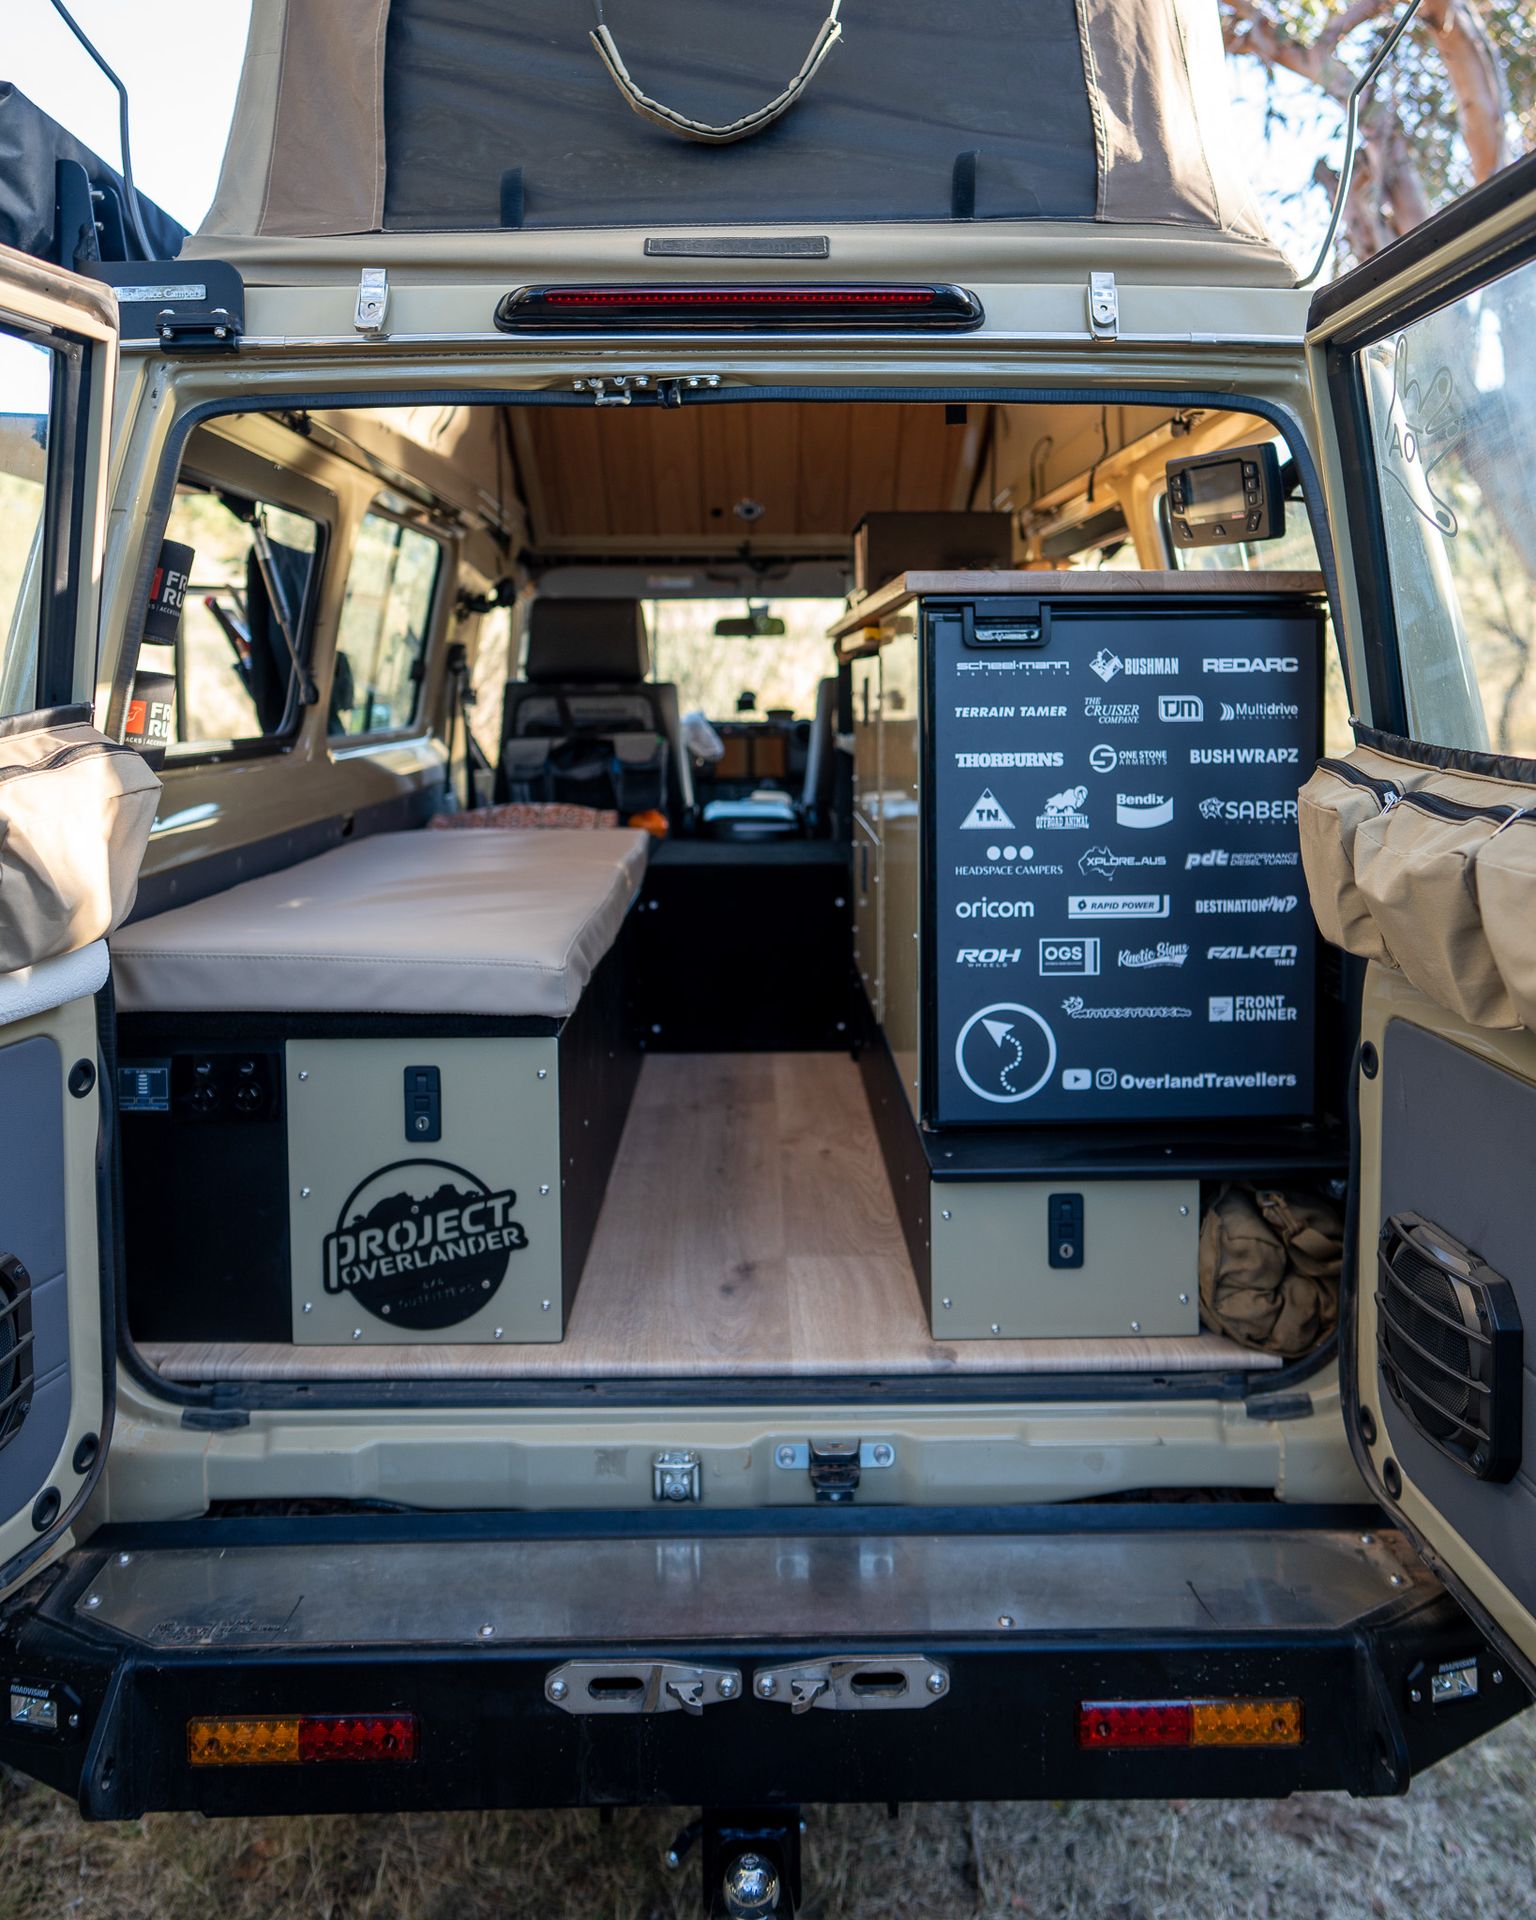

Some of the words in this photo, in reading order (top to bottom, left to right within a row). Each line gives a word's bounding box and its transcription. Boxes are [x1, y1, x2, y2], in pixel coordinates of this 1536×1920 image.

[1125, 658, 1179, 675] BUSHMAN
[1203, 657, 1299, 673] REDARC
[1084, 697, 1102, 705] THE
[1162, 699, 1200, 718] TJM
[1236, 702, 1299, 715] Multidrive
[955, 706, 1015, 718] TERRAIN
[1020, 705, 1067, 717] TAMER
[1084, 704, 1140, 717] CRUISER
[125, 736, 142, 744] ACKS
[955, 752, 1064, 768] THORBURNS
[1119, 751, 1137, 759] ONE
[1139, 750, 1168, 759] STONE
[1119, 758, 1168, 766] ARMRESTS
[1117, 794, 1164, 806] Bendix
[1225, 801, 1298, 819] SABER
[1185, 849, 1229, 871] pdt
[955, 865, 1013, 876] HEADSPACE
[1014, 865, 1064, 876] CAMPERS
[955, 896, 1035, 919] oricom
[1091, 900, 1120, 910] RAPID
[1122, 900, 1155, 910] POWER
[956, 948, 1023, 963] ROH
[1045, 946, 1083, 962] OGS
[1118, 949, 1156, 967] Kinetic
[1156, 942, 1190, 960] Signs
[1206, 944, 1298, 961] FALKEN
[1235, 994, 1286, 1008] FRONT
[1235, 1007, 1298, 1022] RUNNER
[1120, 1072, 1297, 1090] OverlandTravellers
[329, 1195, 511, 1288] PROJECT
[341, 1227, 520, 1286] OVERLANDER
[10, 1683, 49, 1699] ROADVISION
